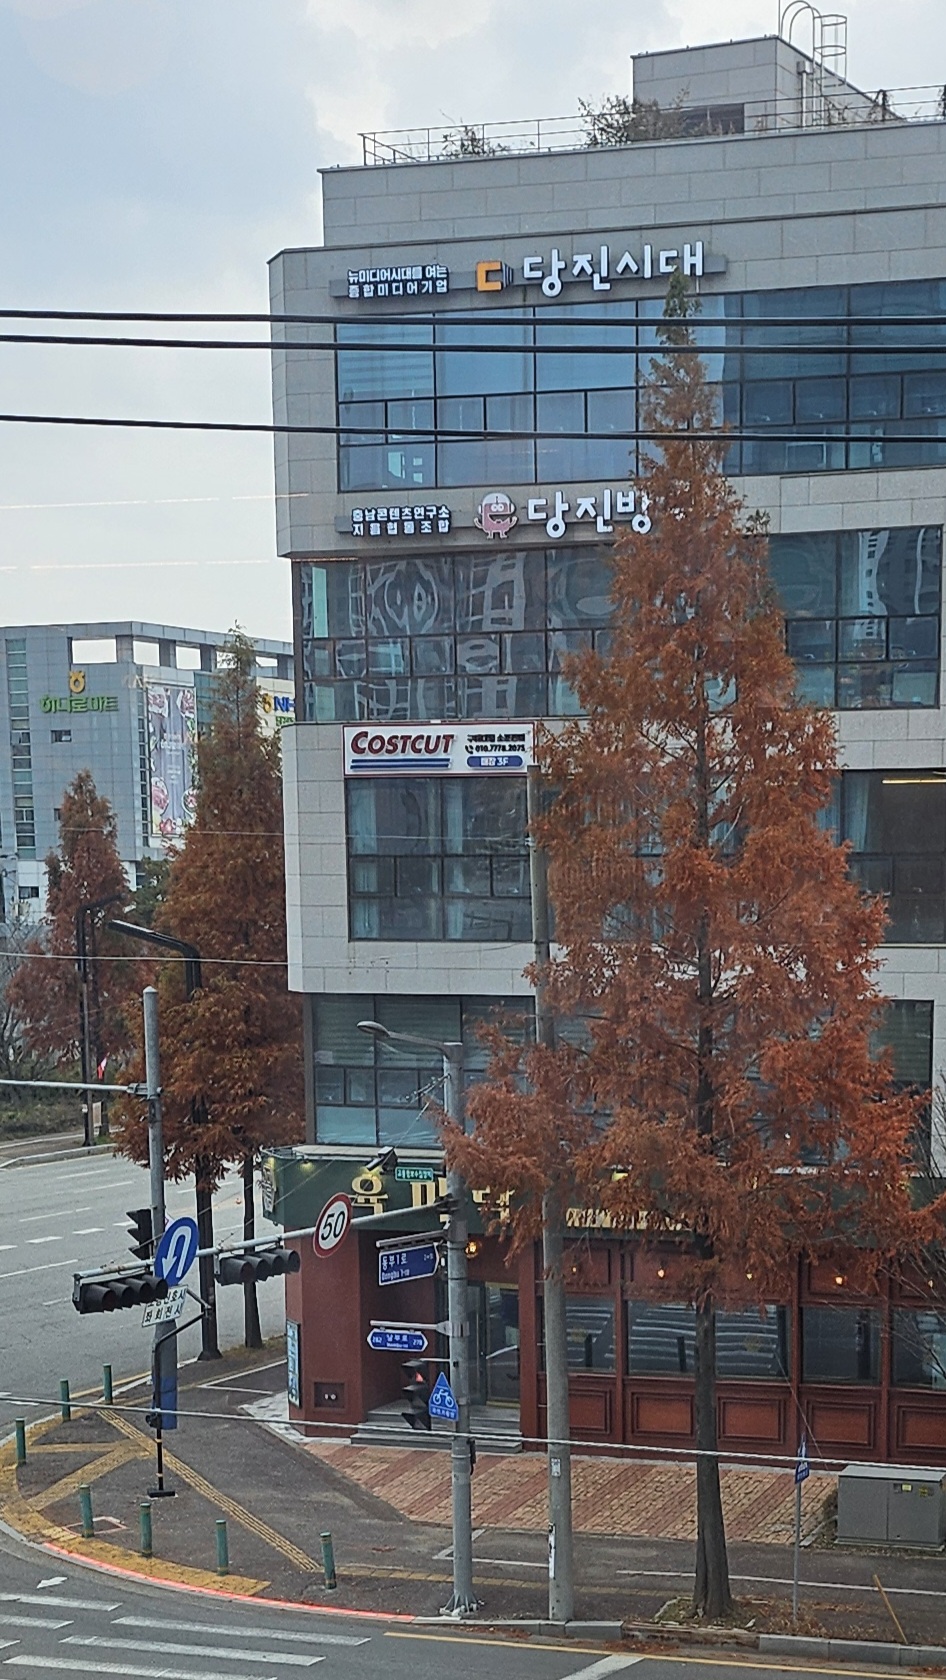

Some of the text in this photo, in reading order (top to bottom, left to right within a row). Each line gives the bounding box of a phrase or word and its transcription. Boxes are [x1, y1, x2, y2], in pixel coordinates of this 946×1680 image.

[425, 264, 448, 279] 여는
[523, 240, 703, 298] 당진시대
[527, 488, 652, 539] 당진방
[41, 695, 119, 713] 하나로마트
[321, 1211, 345, 1240] 50
